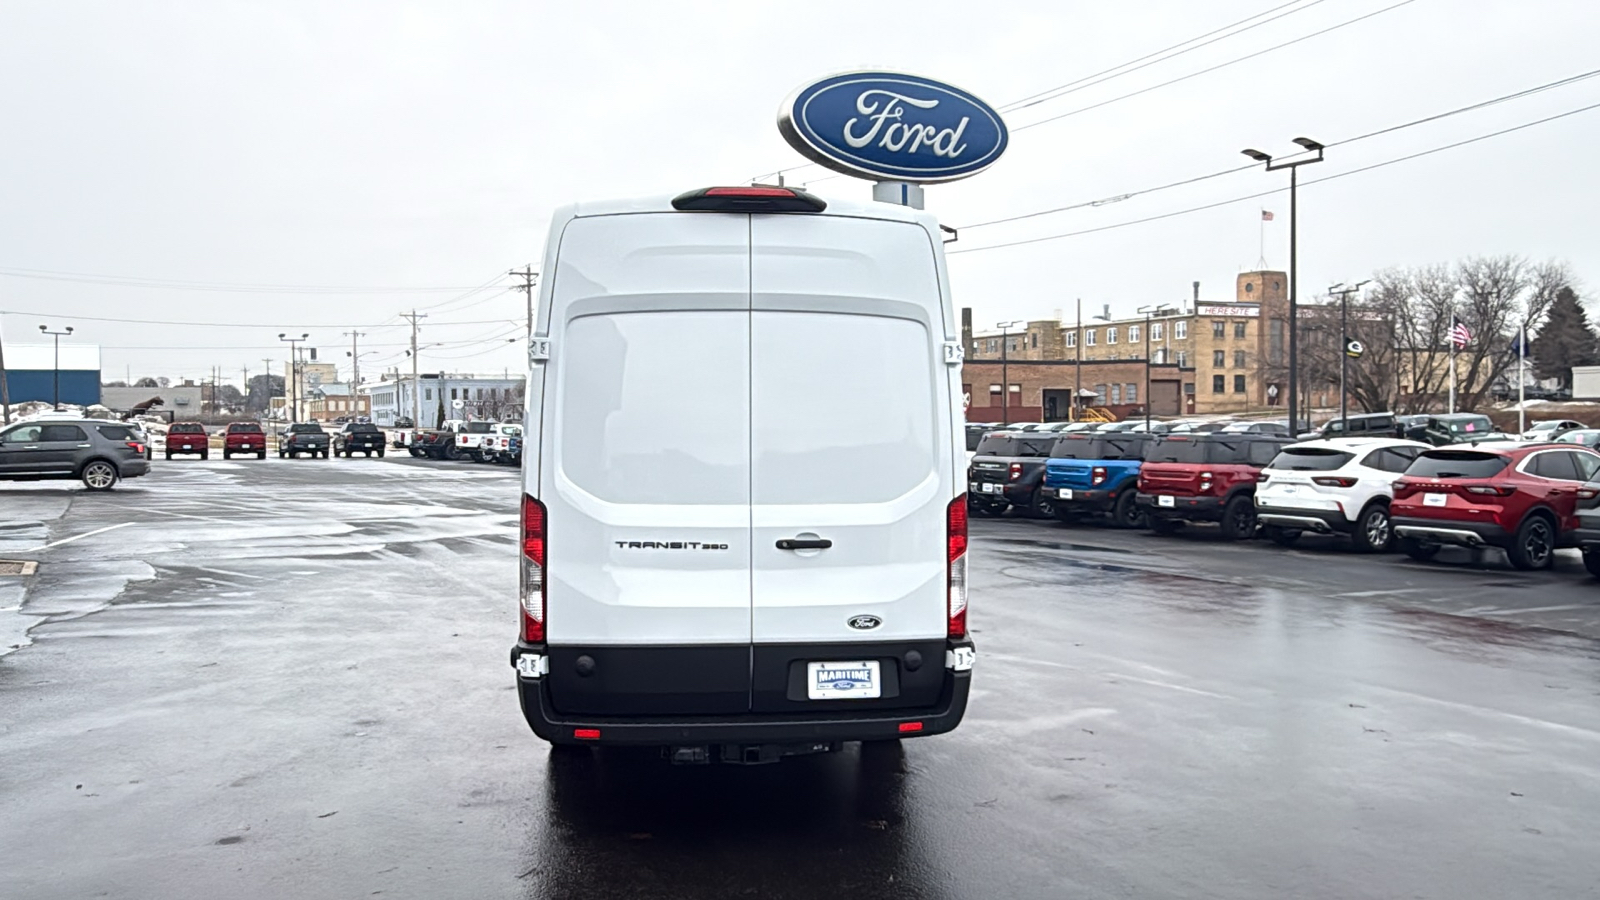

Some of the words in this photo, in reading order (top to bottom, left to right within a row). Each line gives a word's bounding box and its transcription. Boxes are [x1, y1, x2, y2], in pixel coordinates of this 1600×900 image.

[843, 89, 970, 158] Ford
[1204, 306, 1250, 316] HERESITE
[615, 541, 701, 550] TRANSIT
[854, 618, 876, 628] Ford
[819, 670, 870, 683] MARITIME
